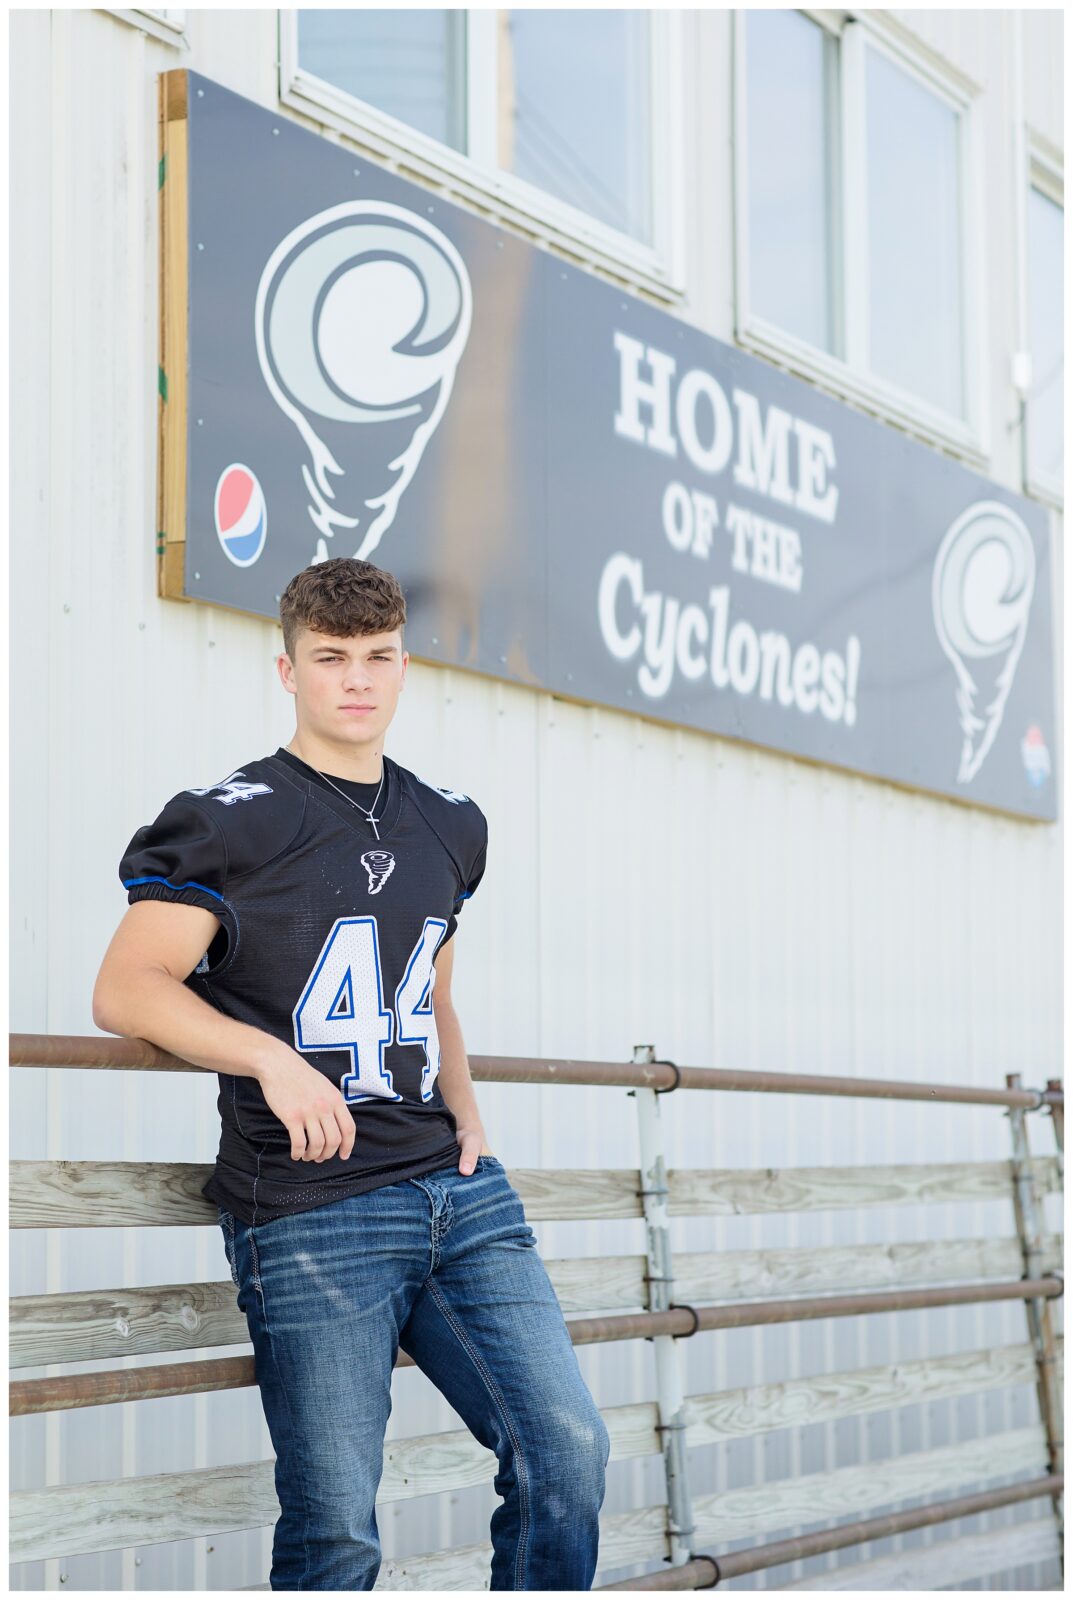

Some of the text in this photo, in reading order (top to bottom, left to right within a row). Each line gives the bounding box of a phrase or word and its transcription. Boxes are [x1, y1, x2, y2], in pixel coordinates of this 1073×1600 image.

[614, 332, 838, 523] HOME
[663, 482, 802, 592] OF THE
[599, 552, 859, 726] Cyclones!
[292, 916, 448, 1104] 44
